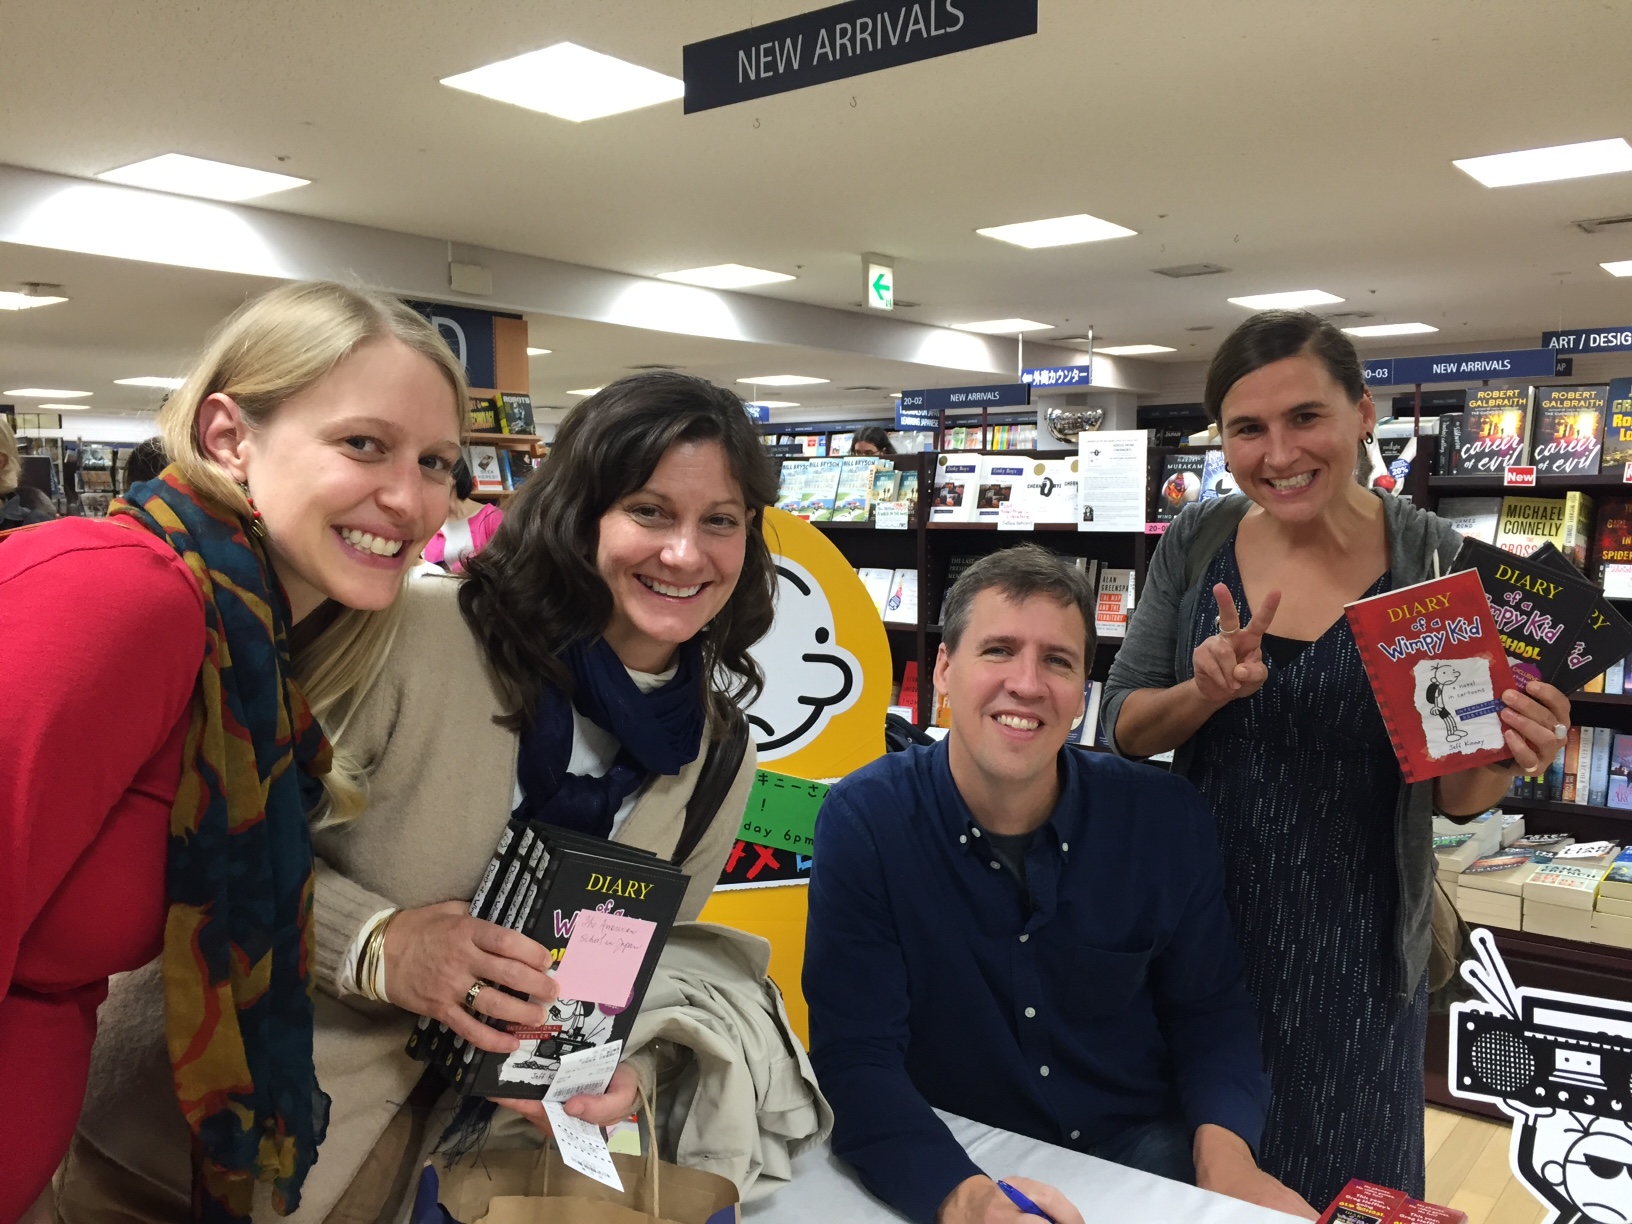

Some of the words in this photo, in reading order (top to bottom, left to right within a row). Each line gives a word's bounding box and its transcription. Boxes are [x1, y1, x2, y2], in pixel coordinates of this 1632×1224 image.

[737, 35, 802, 83] NEW
[813, 0, 965, 65] ARRIVALS
[1549, 335, 1576, 349] ART
[1589, 331, 1632, 347] DESIG
[1363, 368, 1388, 379] 0-03
[1432, 363, 1457, 374] NEW
[1460, 359, 1511, 373] ARRIVALS
[903, 397, 923, 405] 20-02
[950, 393, 966, 402] NEW
[967, 391, 999, 401] ARRIVALS
[1469, 398, 1526, 407] GALBRAITH
[1477, 389, 1520, 399] ROBERT
[1551, 391, 1597, 399] ROBERT
[1542, 400, 1603, 408] GALBRAITH
[1612, 413, 1632, 428] Ro
[1461, 435, 1520, 459] career
[1534, 435, 1596, 460] career
[1464, 458, 1475, 469] of
[1478, 443, 1524, 471] evil
[1538, 460, 1549, 470] of
[1552, 444, 1600, 473] evil
[1507, 470, 1534, 482] New
[1506, 504, 1563, 521] MICHAEL
[1503, 520, 1562, 537] CONNELLY
[1495, 564, 1564, 599] DIARY
[1387, 592, 1451, 623] DIARY
[1504, 591, 1522, 605] of
[1521, 601, 1533, 611] a
[1411, 617, 1426, 631] of
[1431, 618, 1441, 628] a
[1524, 610, 1564, 644] Kid
[1377, 630, 1446, 662] Wimpy
[1446, 616, 1482, 644] Kid
[1457, 688, 1485, 698] cartoons
[1459, 680, 1475, 689] novel
[760, 799, 766, 811] !
[744, 822, 772, 837] day
[784, 829, 814, 845] 6pm
[585, 873, 654, 900] DIARY
[596, 899, 614, 913] of
[1345, 1194, 1361, 1202] Greg
